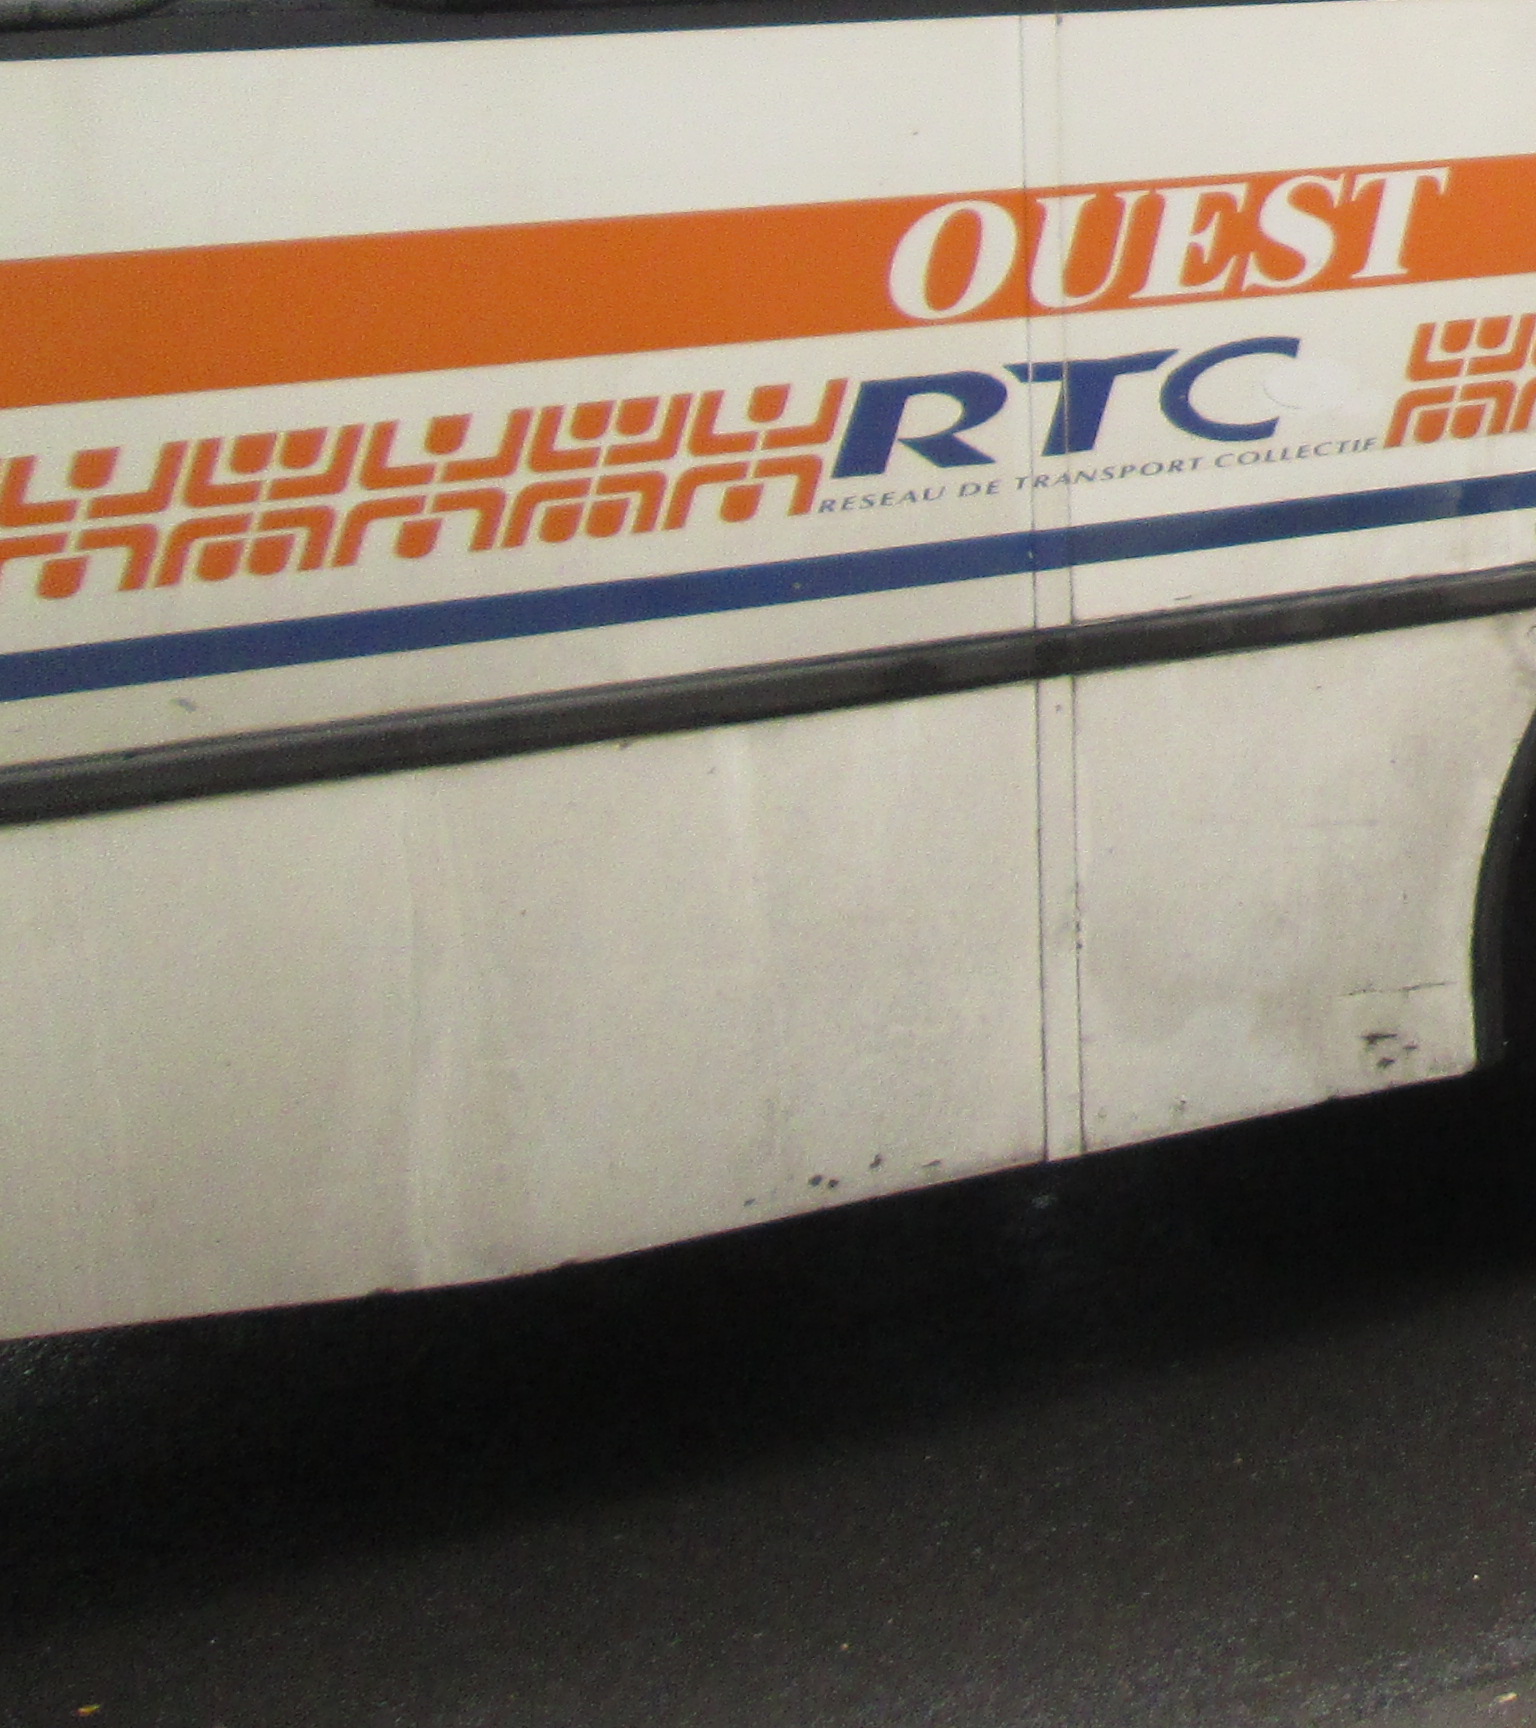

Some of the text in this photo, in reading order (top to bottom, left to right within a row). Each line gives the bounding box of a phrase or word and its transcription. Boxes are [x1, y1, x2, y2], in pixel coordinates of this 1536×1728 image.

[888, 167, 1450, 320] OUEST
[818, 436, 1379, 514] RESEAU DE TRANSPORT COLLECTIF
[831, 336, 1301, 479] RTC
